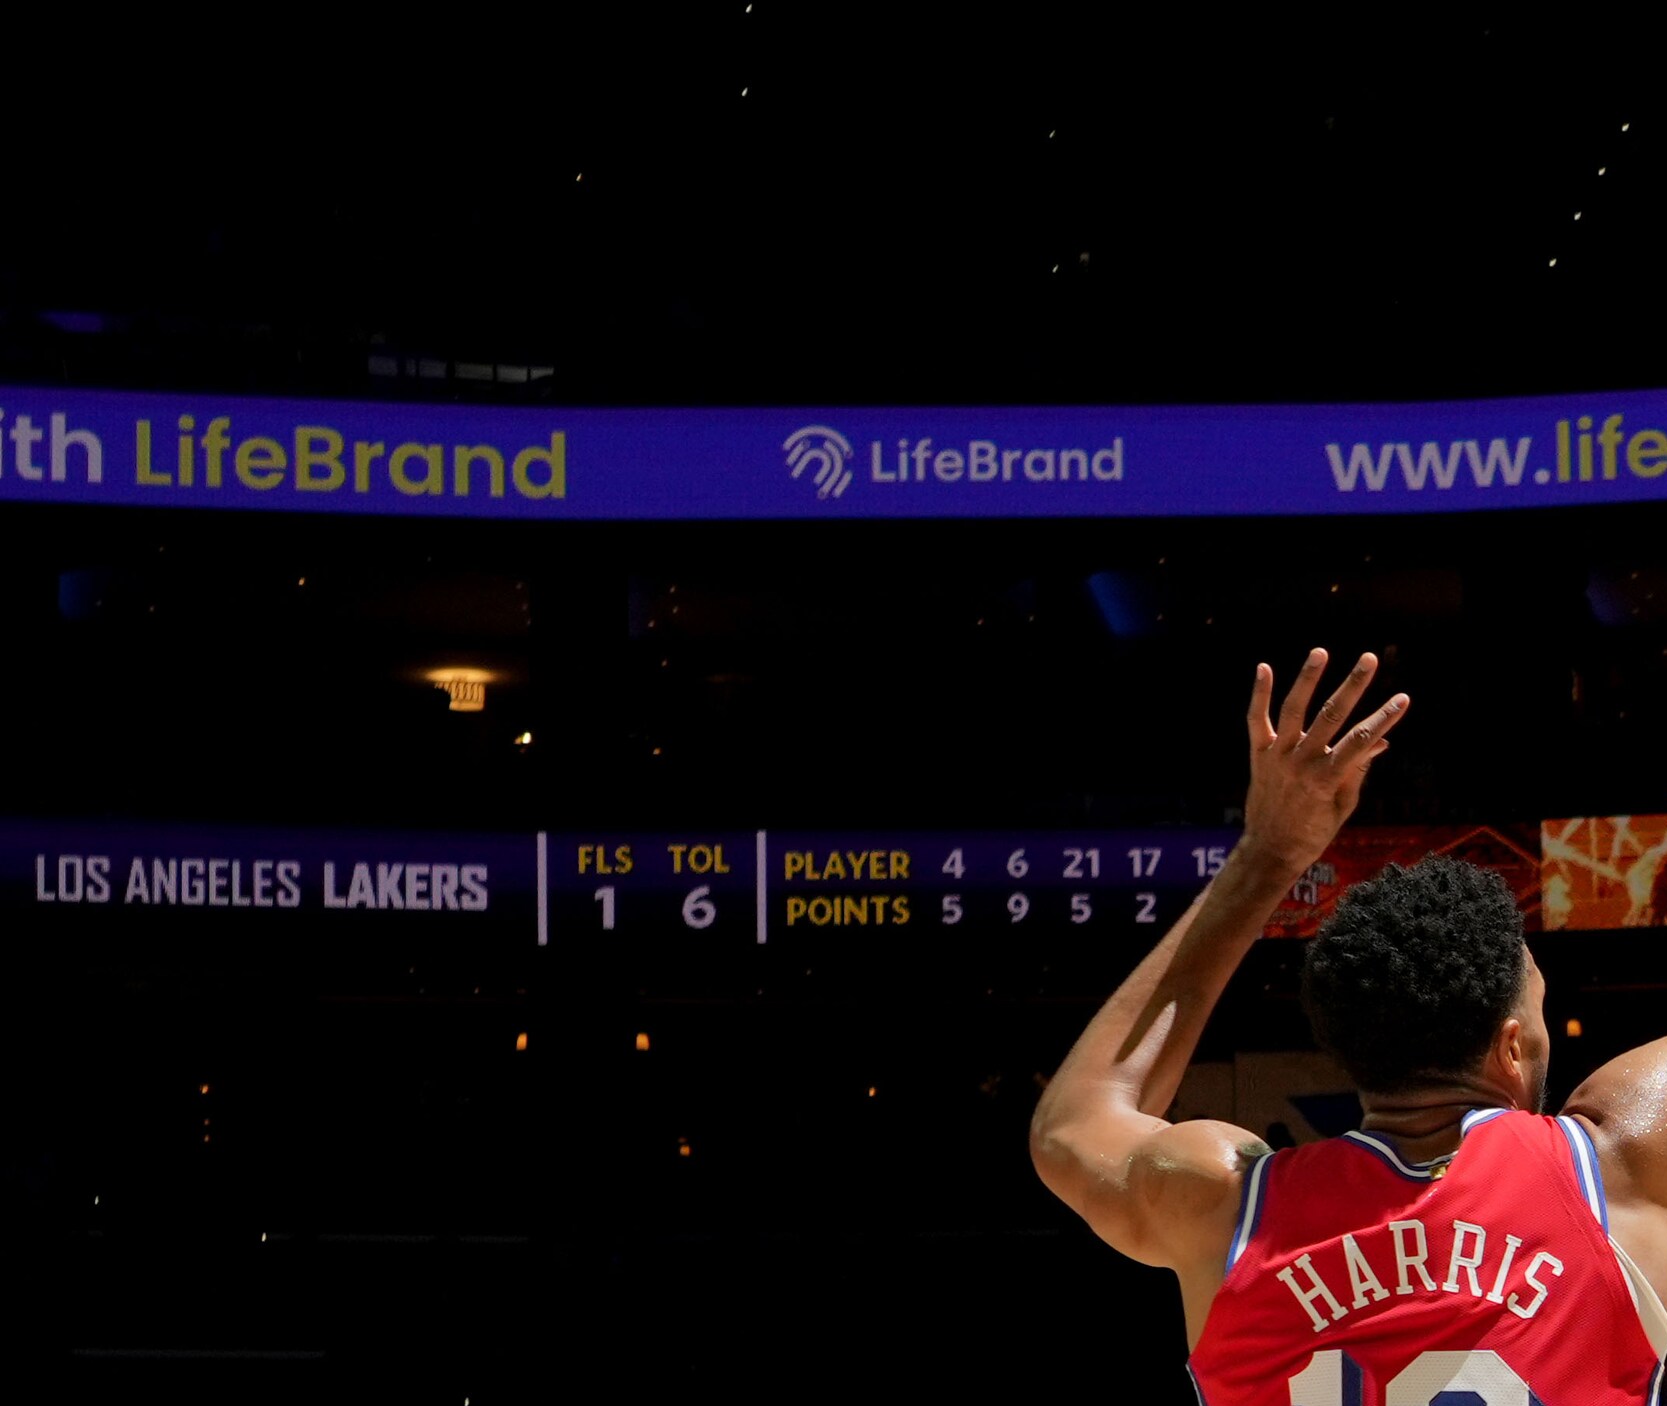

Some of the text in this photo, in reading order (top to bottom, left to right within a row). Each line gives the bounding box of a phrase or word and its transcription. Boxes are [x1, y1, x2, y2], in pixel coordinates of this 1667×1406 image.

[0, 408, 566, 499] th LifeBrand
[871, 437, 1123, 482] LifeBrand
[578, 845, 730, 874] FLS TOL
[784, 847, 1226, 881] PLAYER 4 6 21 17 15
[36, 854, 488, 911] LOS ANGELES LAKERS
[594, 886, 716, 930] 1 6
[786, 894, 1156, 926] POINTS 5 9 5 2
[1276, 1219, 1564, 1333] HARRIS
